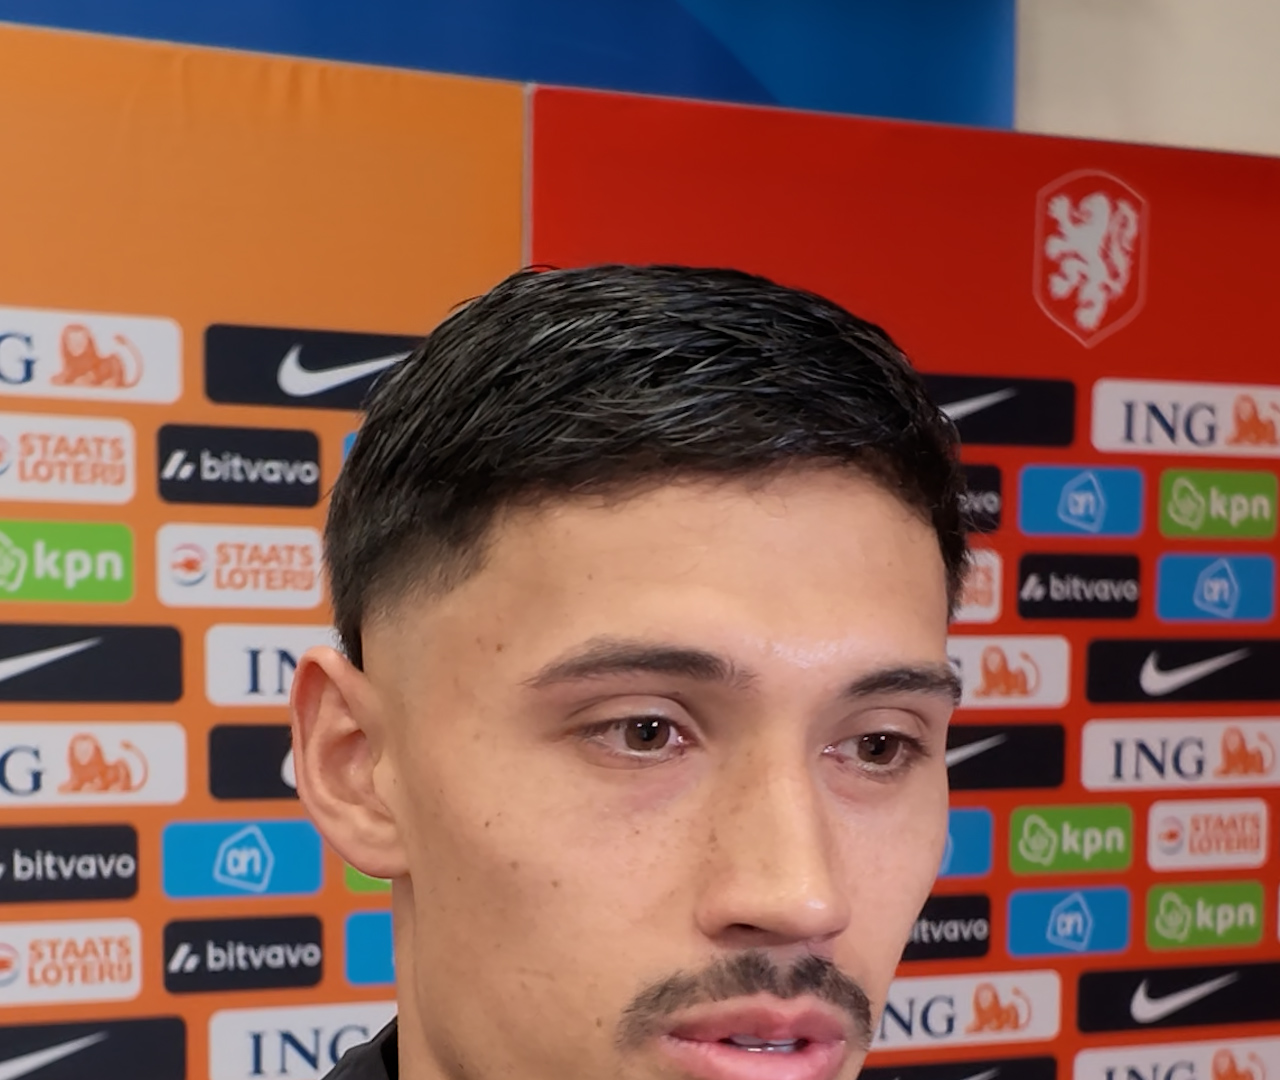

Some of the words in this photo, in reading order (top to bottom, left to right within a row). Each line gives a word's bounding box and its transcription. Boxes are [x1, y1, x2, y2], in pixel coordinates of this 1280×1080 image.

[1124, 402, 1216, 447] ING
[20, 432, 124, 458] STAATS
[201, 451, 319, 484] bitvavo
[1208, 488, 1270, 526] kpn
[34, 540, 123, 589] kpn
[217, 542, 314, 567] STAATS
[1050, 575, 1138, 601] bitvavo
[1113, 739, 1205, 781] ING
[1061, 822, 1124, 860] kpn
[14, 850, 135, 880] bitvavo
[912, 918, 989, 944] itvavo
[1195, 900, 1256, 935] kpn
[29, 937, 131, 962] STAATS
[207, 942, 321, 970] bitvavo
[878, 995, 956, 1040] NG
